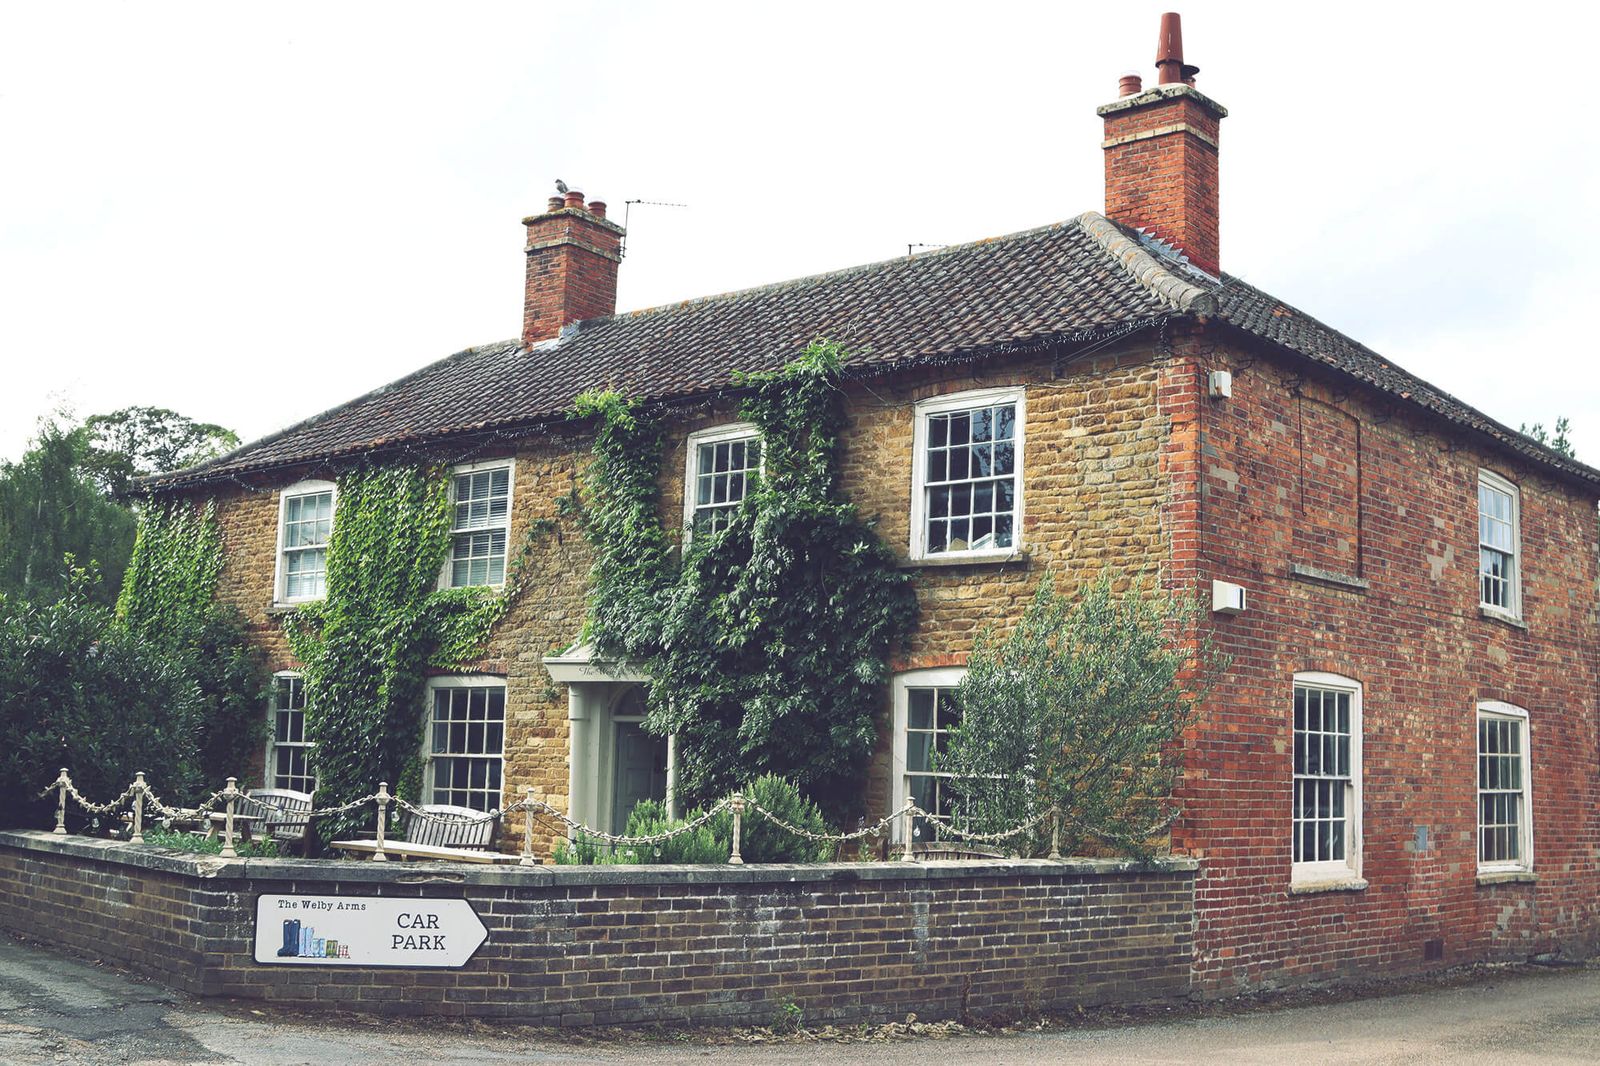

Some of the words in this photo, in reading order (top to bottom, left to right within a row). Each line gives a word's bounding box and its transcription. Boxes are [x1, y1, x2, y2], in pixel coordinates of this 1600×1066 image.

[277, 899, 298, 909] The
[301, 900, 334, 912] Welby
[336, 901, 367, 911] Arms
[397, 913, 440, 929] CAR
[391, 934, 446, 950] PARK
